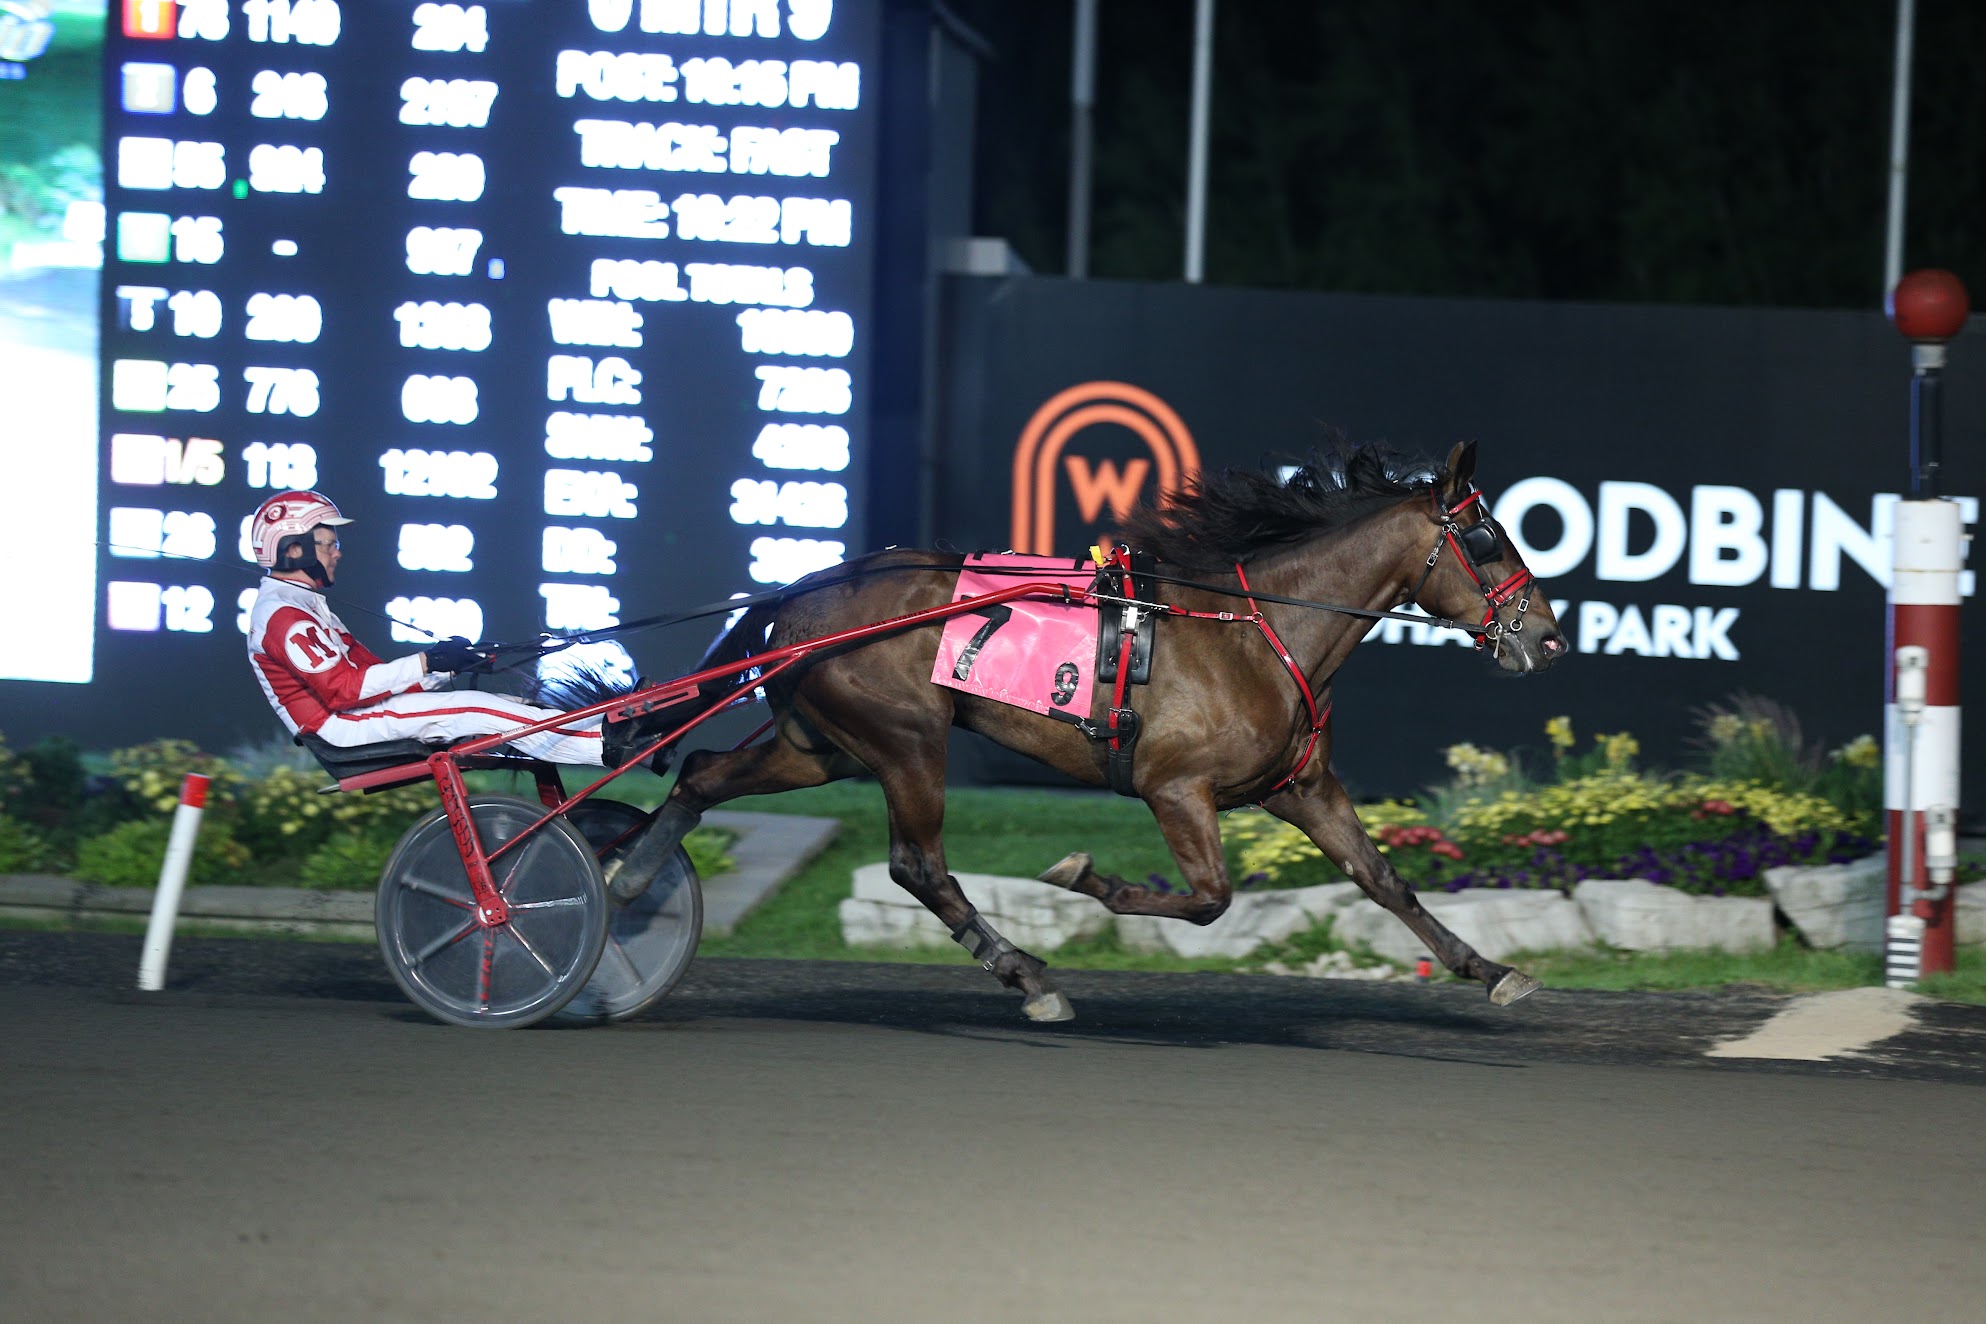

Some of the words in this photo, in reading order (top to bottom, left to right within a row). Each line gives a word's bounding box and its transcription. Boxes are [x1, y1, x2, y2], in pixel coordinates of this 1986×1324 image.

[1065, 455, 1149, 525] W
[289, 626, 337, 669] M
[952, 595, 1013, 681] 7
[1577, 600, 1741, 662] PARK
[1051, 661, 1079, 706] 9
